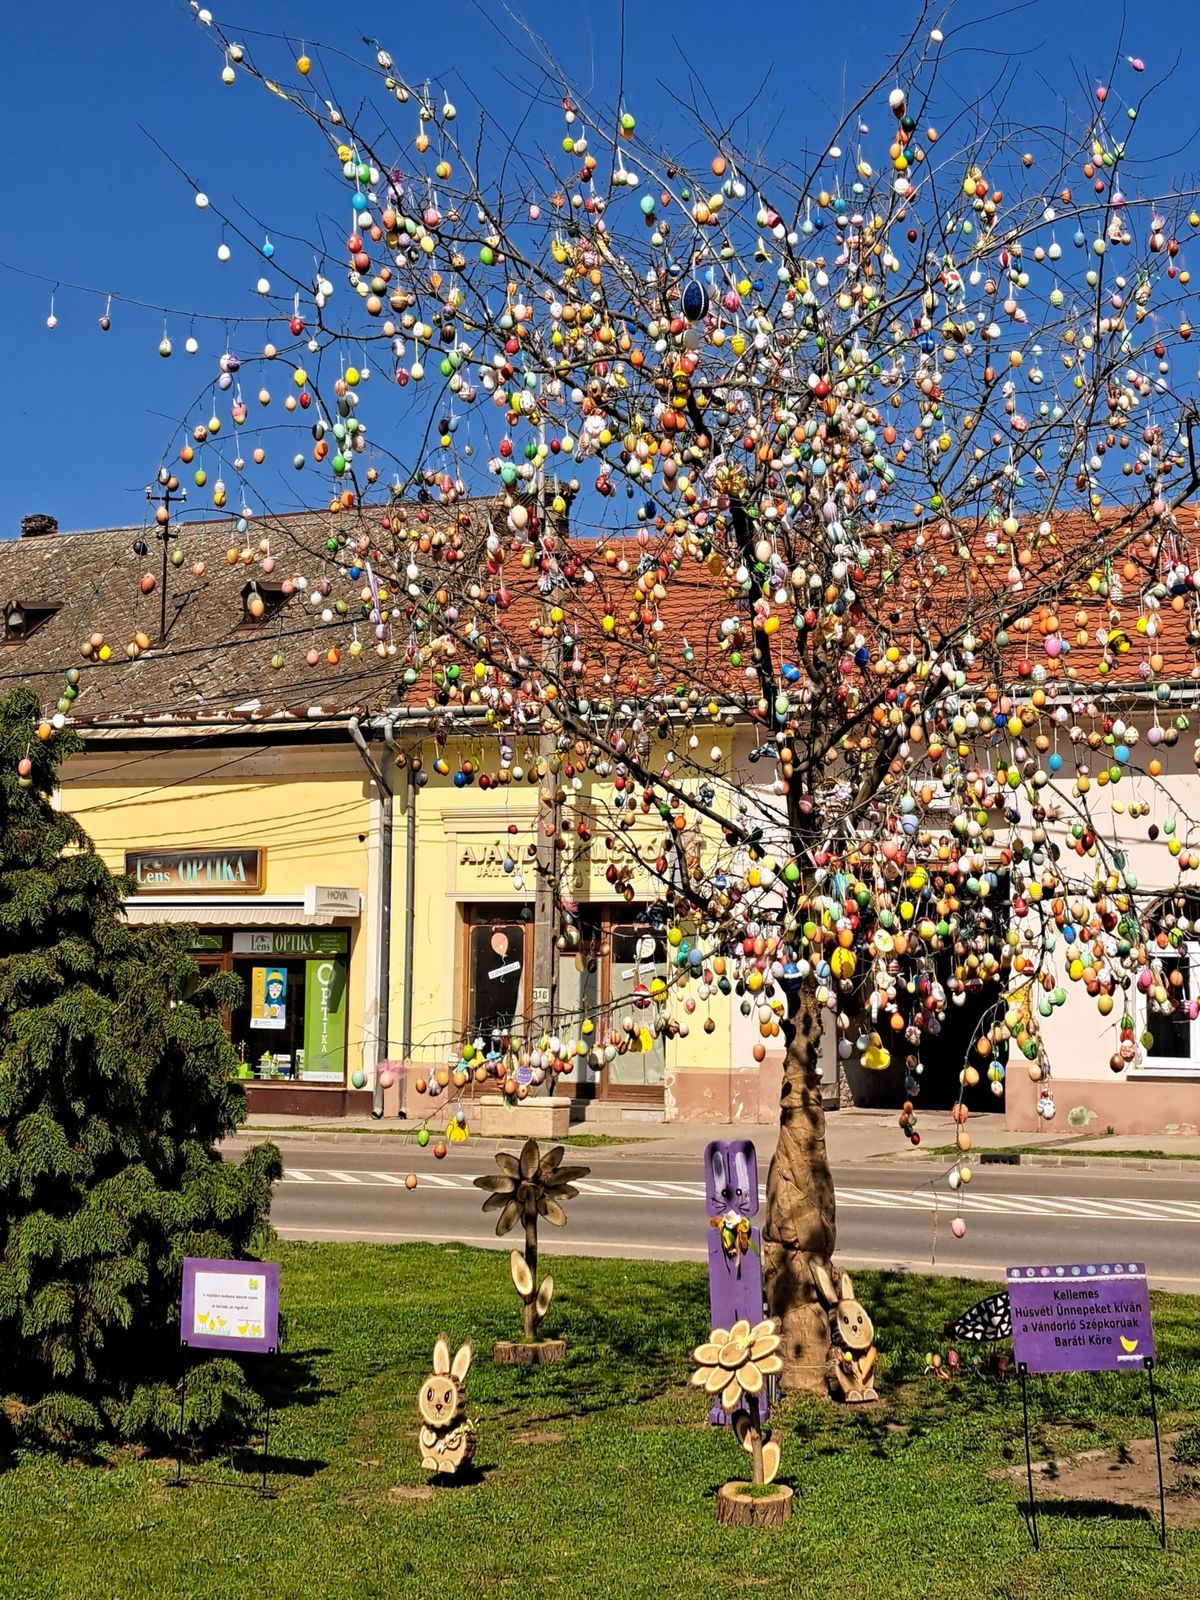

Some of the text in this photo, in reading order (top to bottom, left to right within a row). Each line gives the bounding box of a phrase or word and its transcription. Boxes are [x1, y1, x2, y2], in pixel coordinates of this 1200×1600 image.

[136, 856, 247, 884] Lens OPTIKA
[327, 890, 348, 901] HOYA
[251, 934, 270, 951] Lens
[275, 933, 314, 951] OPTIKA
[317, 963, 335, 1053] OPTIKA
[1053, 1290, 1100, 1301] Kellemes
[1015, 1301, 1142, 1318] Húsvéti Ünnepeket kíván
[1031, 1320, 1076, 1333] Vándorló
[1079, 1317, 1140, 1331] Szépkorúak
[1055, 1336, 1086, 1347] Baráti
